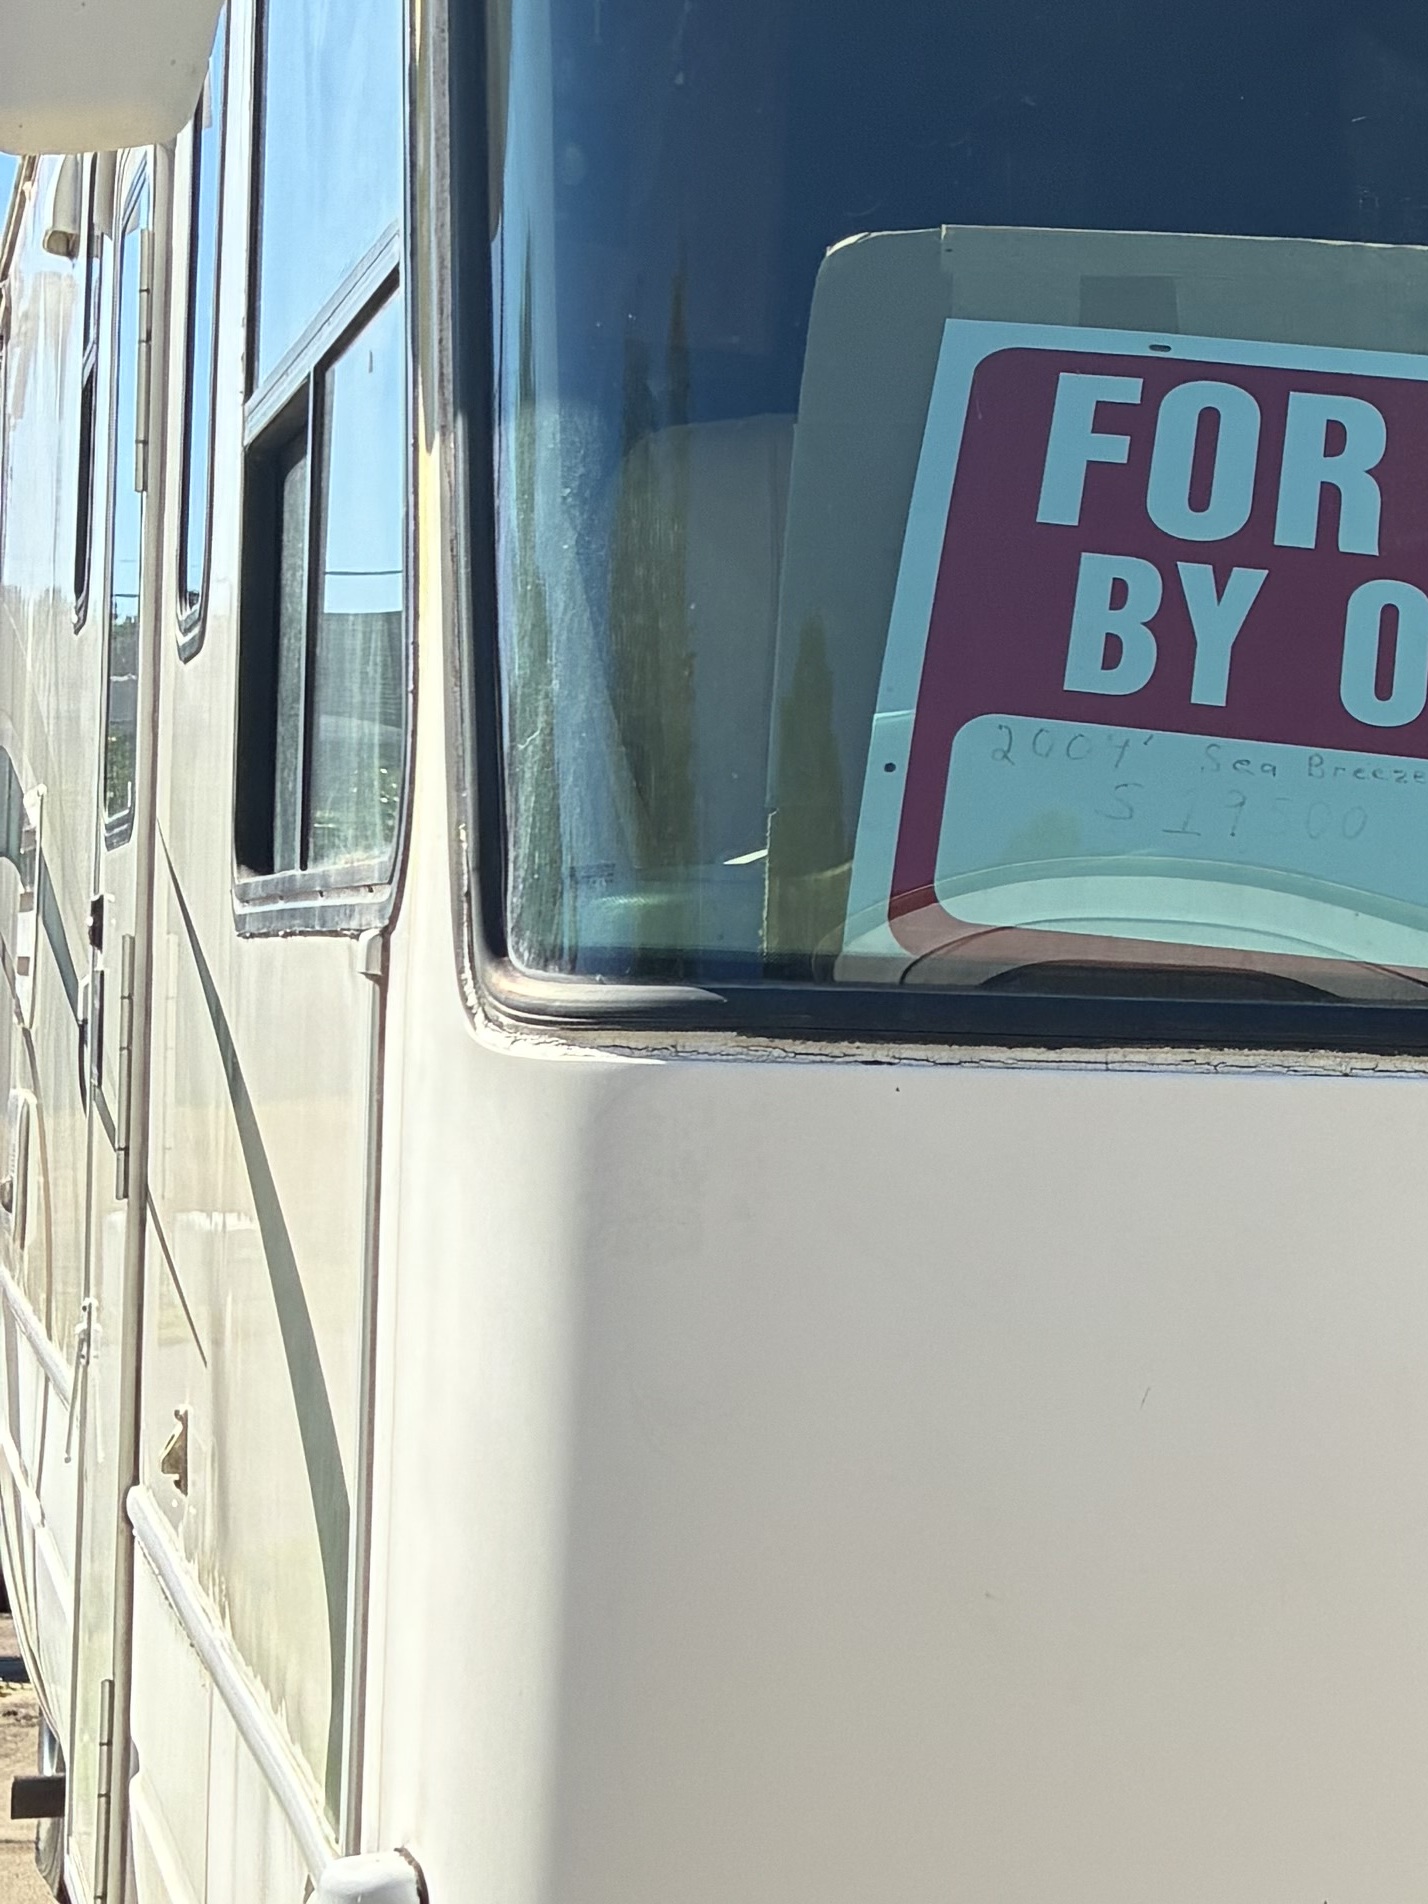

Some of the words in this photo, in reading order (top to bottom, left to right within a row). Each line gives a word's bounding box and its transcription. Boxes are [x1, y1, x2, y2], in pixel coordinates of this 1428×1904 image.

[1035, 371, 1388, 557] FOR
[1063, 552, 1269, 707] BY
[1200, 742, 1278, 779] Sea
[1306, 752, 1428, 784] Breeze
